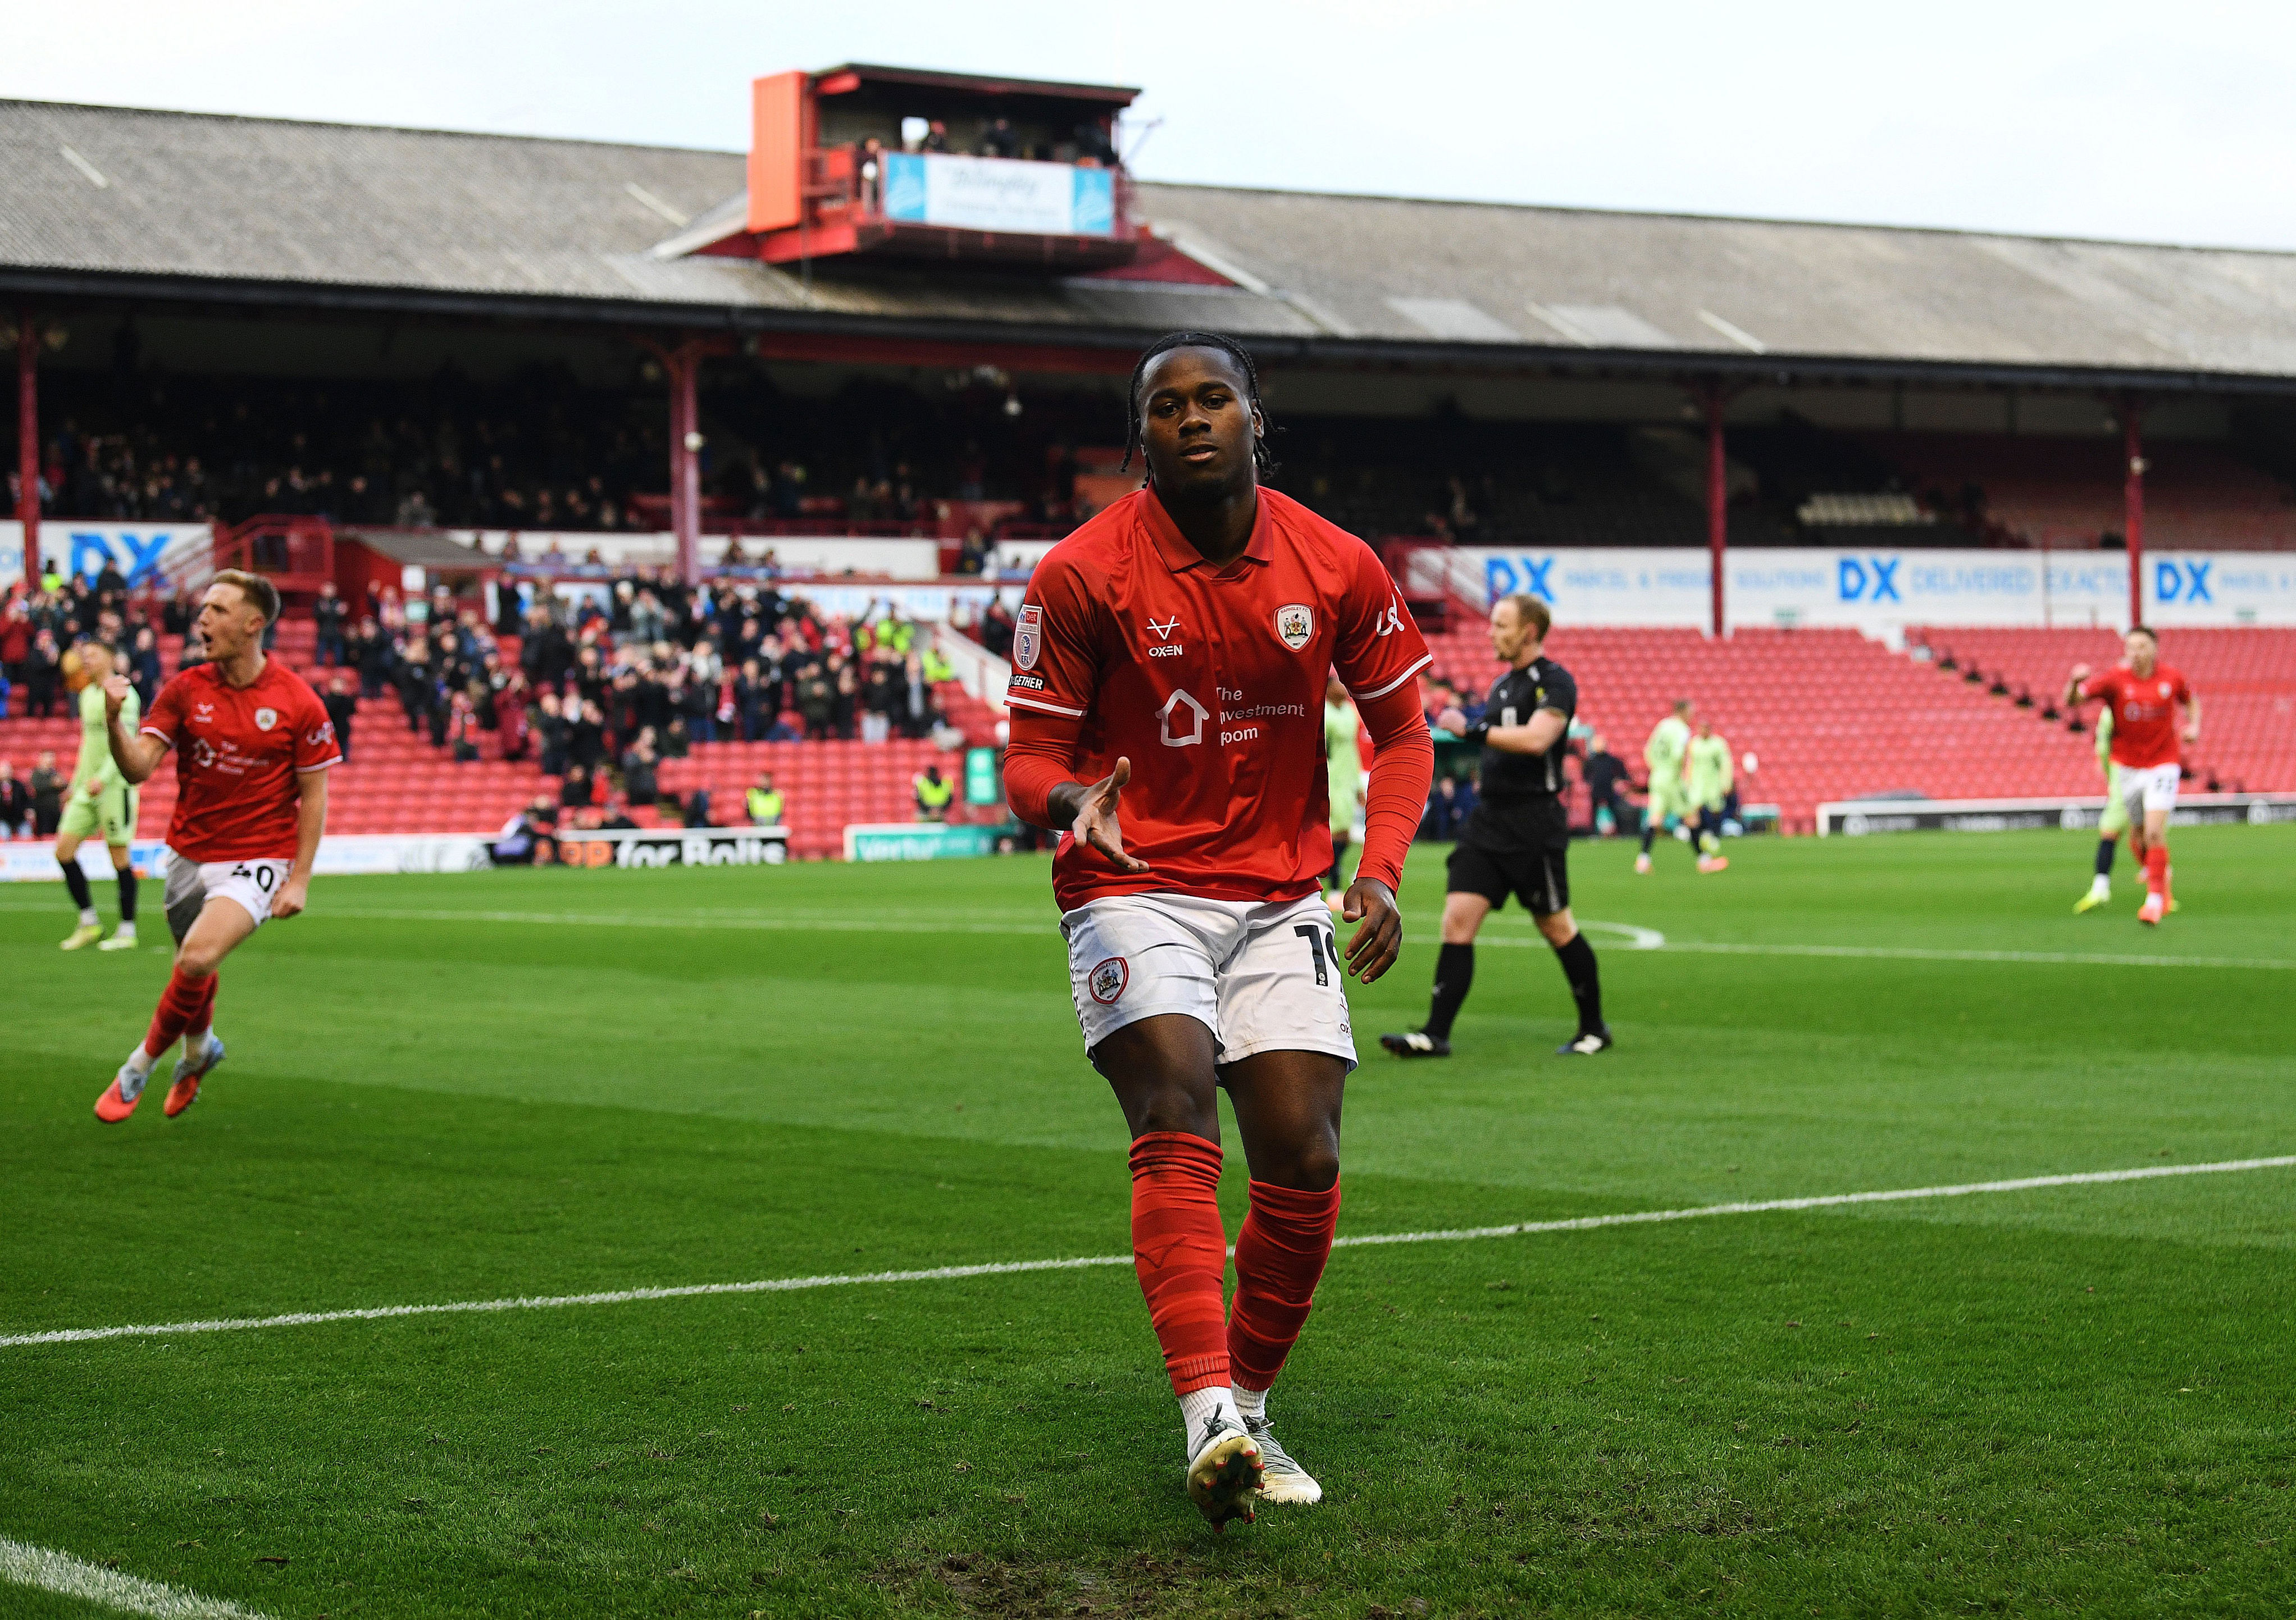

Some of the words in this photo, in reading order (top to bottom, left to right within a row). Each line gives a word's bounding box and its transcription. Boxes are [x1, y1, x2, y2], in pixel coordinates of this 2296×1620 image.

[70, 533, 171, 591] DX
[1486, 556, 1556, 605] DX
[1838, 555, 1902, 603] DX
[2154, 559, 2213, 605] DX
[1026, 612, 1037, 622] bet
[1021, 655, 1029, 664] EFL
[1149, 644, 1183, 658] OXEN
[1216, 687, 1242, 701] The
